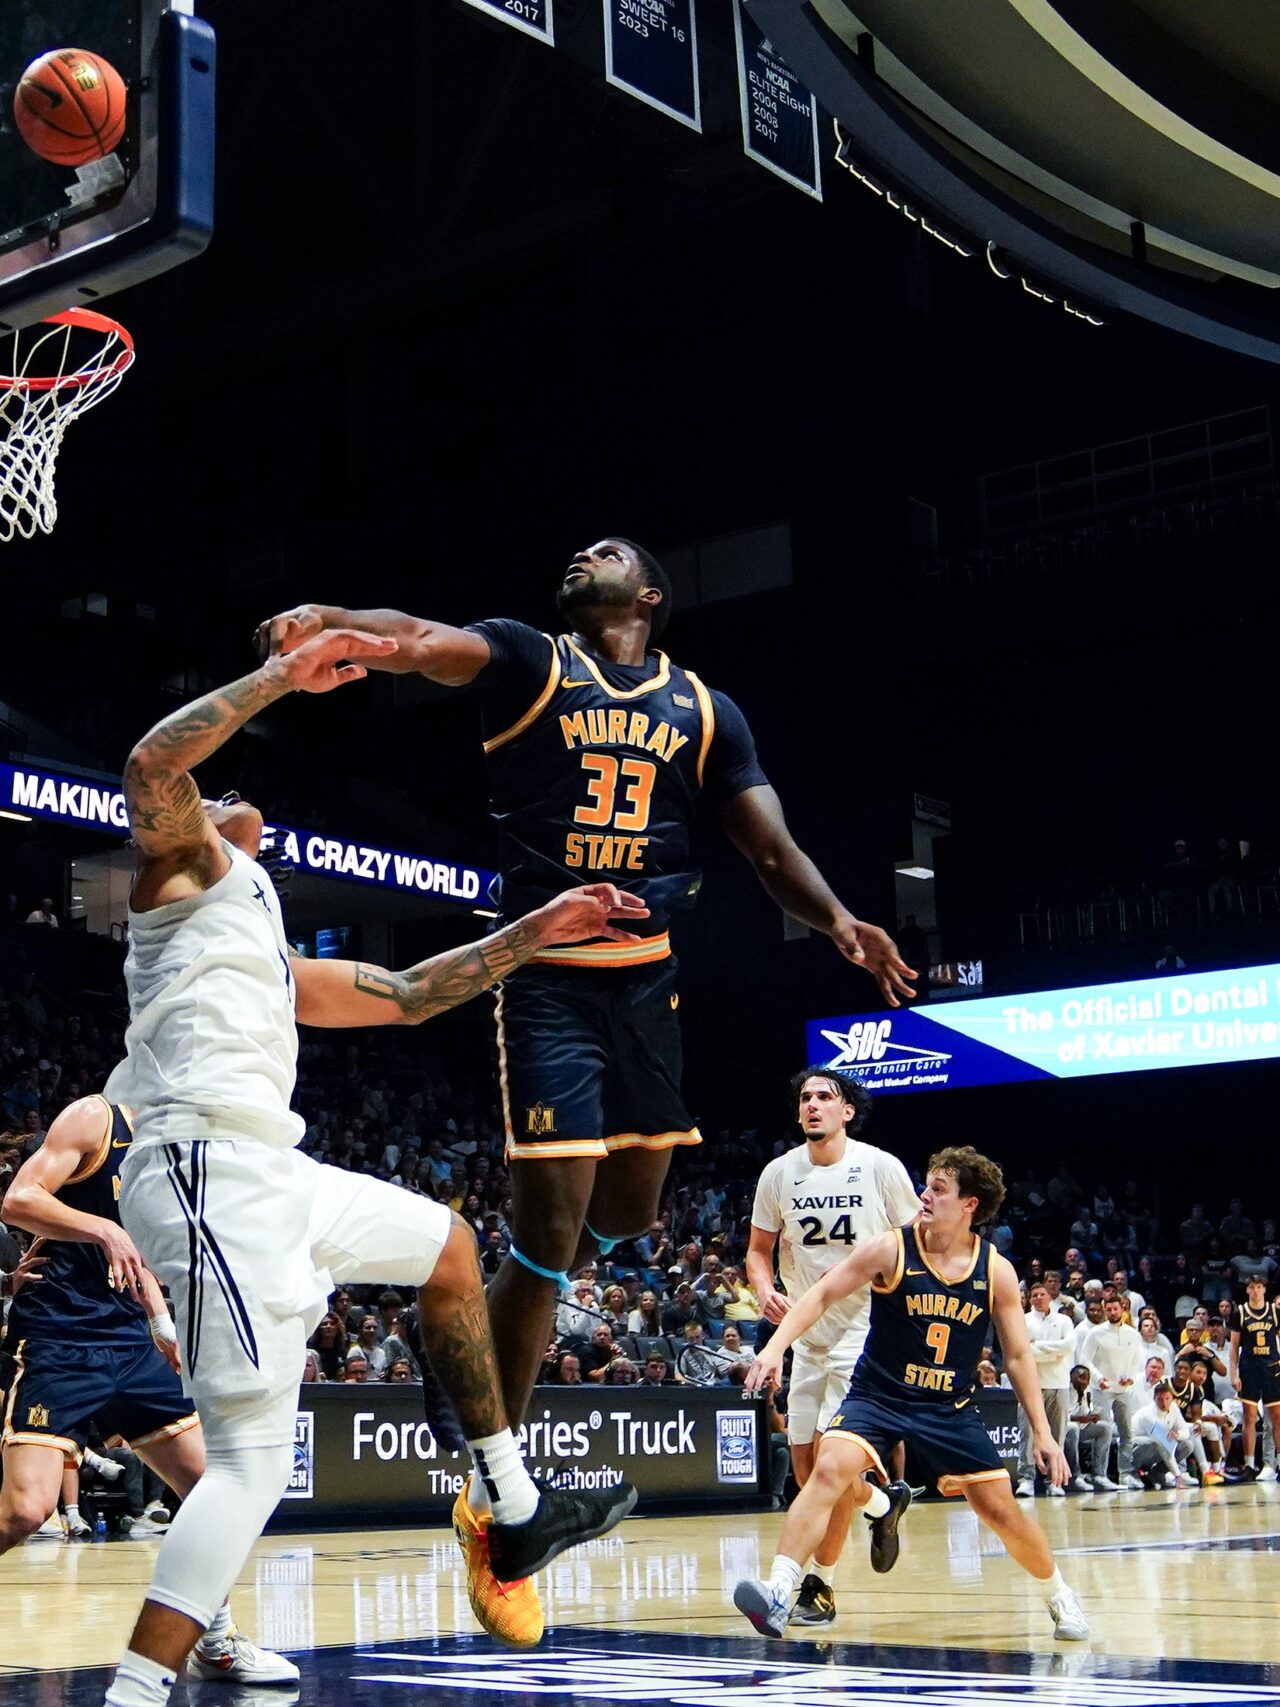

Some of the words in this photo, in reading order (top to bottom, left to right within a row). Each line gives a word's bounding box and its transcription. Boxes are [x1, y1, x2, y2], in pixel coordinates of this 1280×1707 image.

[618, 11, 649, 38] 2023
[620, 0, 668, 32] SWEET
[671, 26, 685, 43] 16
[749, 70, 778, 98] ELITE
[780, 91, 810, 118] EIGHT
[766, 67, 791, 93] NCAA
[752, 87, 777, 113] 2004
[755, 120, 777, 143] 2017
[558, 709, 689, 763] MURRAY
[12, 772, 130, 828] MAKING
[574, 752, 657, 832] 33
[306, 836, 391, 880] CRAZY
[394, 854, 480, 900] WORLD
[565, 833, 649, 870] STATE
[1002, 1006, 1054, 1034] The
[1061, 992, 1163, 1028] Official
[1171, 978, 1268, 1016] Dental
[1057, 1033, 1086, 1063] of
[1093, 1027, 1185, 1060] Xavier
[1192, 1018, 1278, 1051] Unive
[874, 1062, 911, 1075] Dental
[792, 1195, 863, 1210] XAVIER
[798, 1214, 857, 1246] 24
[905, 1293, 983, 1326] MURRAY
[926, 1322, 951, 1365] 9
[904, 1363, 956, 1392] STATE
[610, 1409, 696, 1456] Truck
[721, 1419, 751, 1438] BUILT
[427, 1469, 464, 1495] The
[722, 1459, 752, 1475] TOUGH
